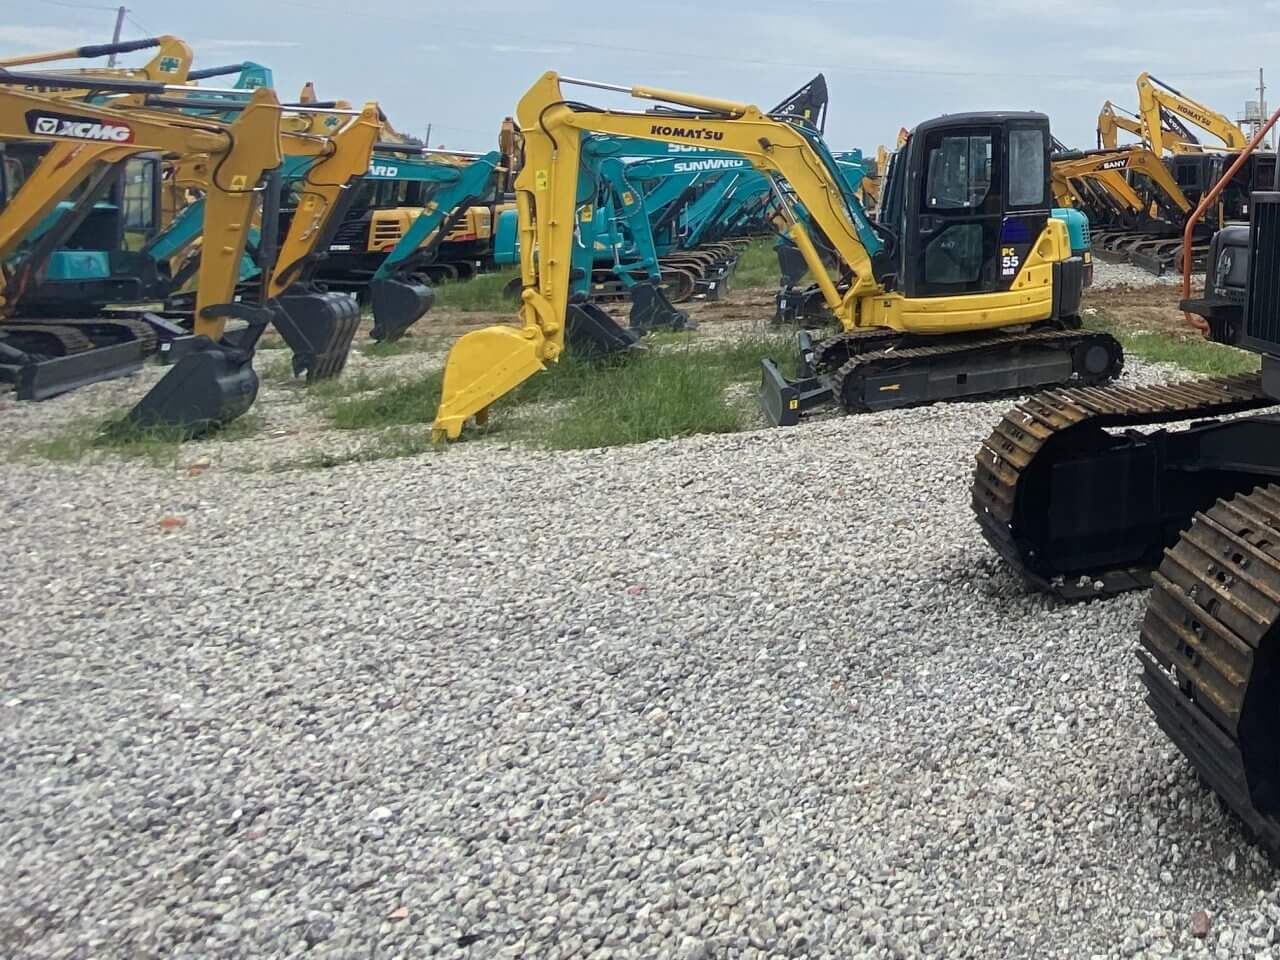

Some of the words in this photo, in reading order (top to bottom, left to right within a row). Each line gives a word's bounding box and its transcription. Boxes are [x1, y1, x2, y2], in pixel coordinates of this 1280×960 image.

[1177, 104, 1212, 127] KOMATSU
[56, 122, 131, 141] XCMG
[650, 125, 724, 141] KOMATSU
[674, 159, 744, 172] SUNWARD
[1104, 160, 1126, 169] SANY
[1002, 247, 1014, 256] PC
[1002, 256, 1019, 267] 55
